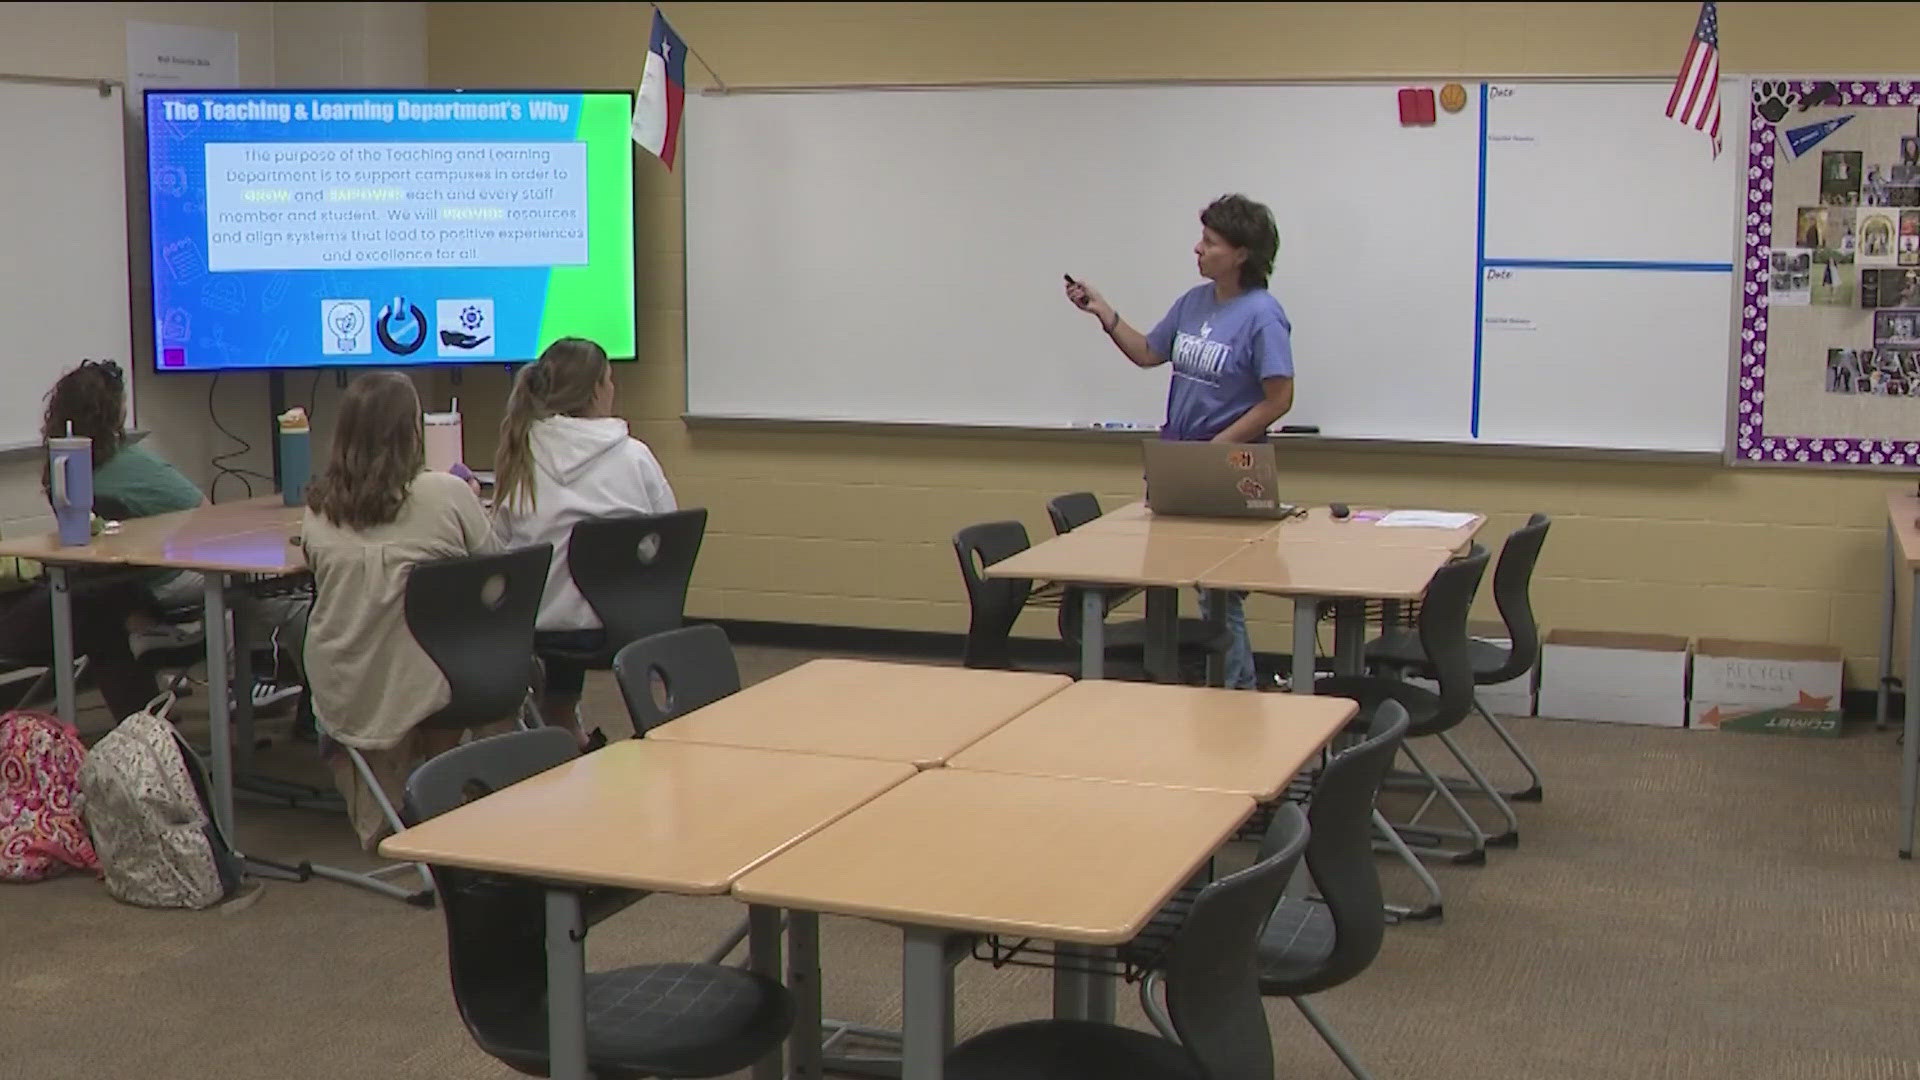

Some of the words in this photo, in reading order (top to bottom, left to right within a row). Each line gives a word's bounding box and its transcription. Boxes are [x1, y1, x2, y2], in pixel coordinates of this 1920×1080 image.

[163, 101, 199, 121] The
[202, 99, 291, 123] Teaching
[294, 103, 309, 121] &
[312, 99, 394, 123] Learning
[398, 99, 522, 122] Department's
[529, 101, 570, 122] Why
[245, 149, 271, 162] The
[274, 151, 336, 164] purpose
[339, 149, 354, 162] of
[357, 149, 382, 162] the
[386, 149, 453, 164] Teaching
[457, 149, 486, 162] and
[489, 149, 551, 164] Learning
[226, 169, 317, 184] Department
[321, 168, 332, 181] is
[335, 168, 351, 182] to
[354, 169, 410, 184] support
[495, 168, 509, 180] in
[512, 168, 549, 180] order
[553, 168, 568, 180] to
[294, 189, 324, 201] and
[406, 189, 443, 201] each
[447, 188, 475, 200] and
[479, 189, 518, 202] every
[522, 187, 554, 200] staff
[219, 210, 283, 223] member
[287, 210, 316, 221] and
[321, 210, 381, 221] student.
[387, 209, 411, 220] We
[414, 208, 437, 220] will
[507, 209, 577, 220] resources
[212, 230, 241, 243] and
[245, 230, 282, 246] align
[286, 231, 347, 245] systems
[351, 230, 381, 242] that
[385, 229, 417, 241] lead
[421, 229, 436, 241] to
[439, 228, 495, 243] positive
[498, 229, 584, 243] experiences
[322, 249, 351, 262] and
[355, 249, 432, 261] excellence
[436, 248, 455, 260] for
[1764, 717, 1836, 730] COMET
